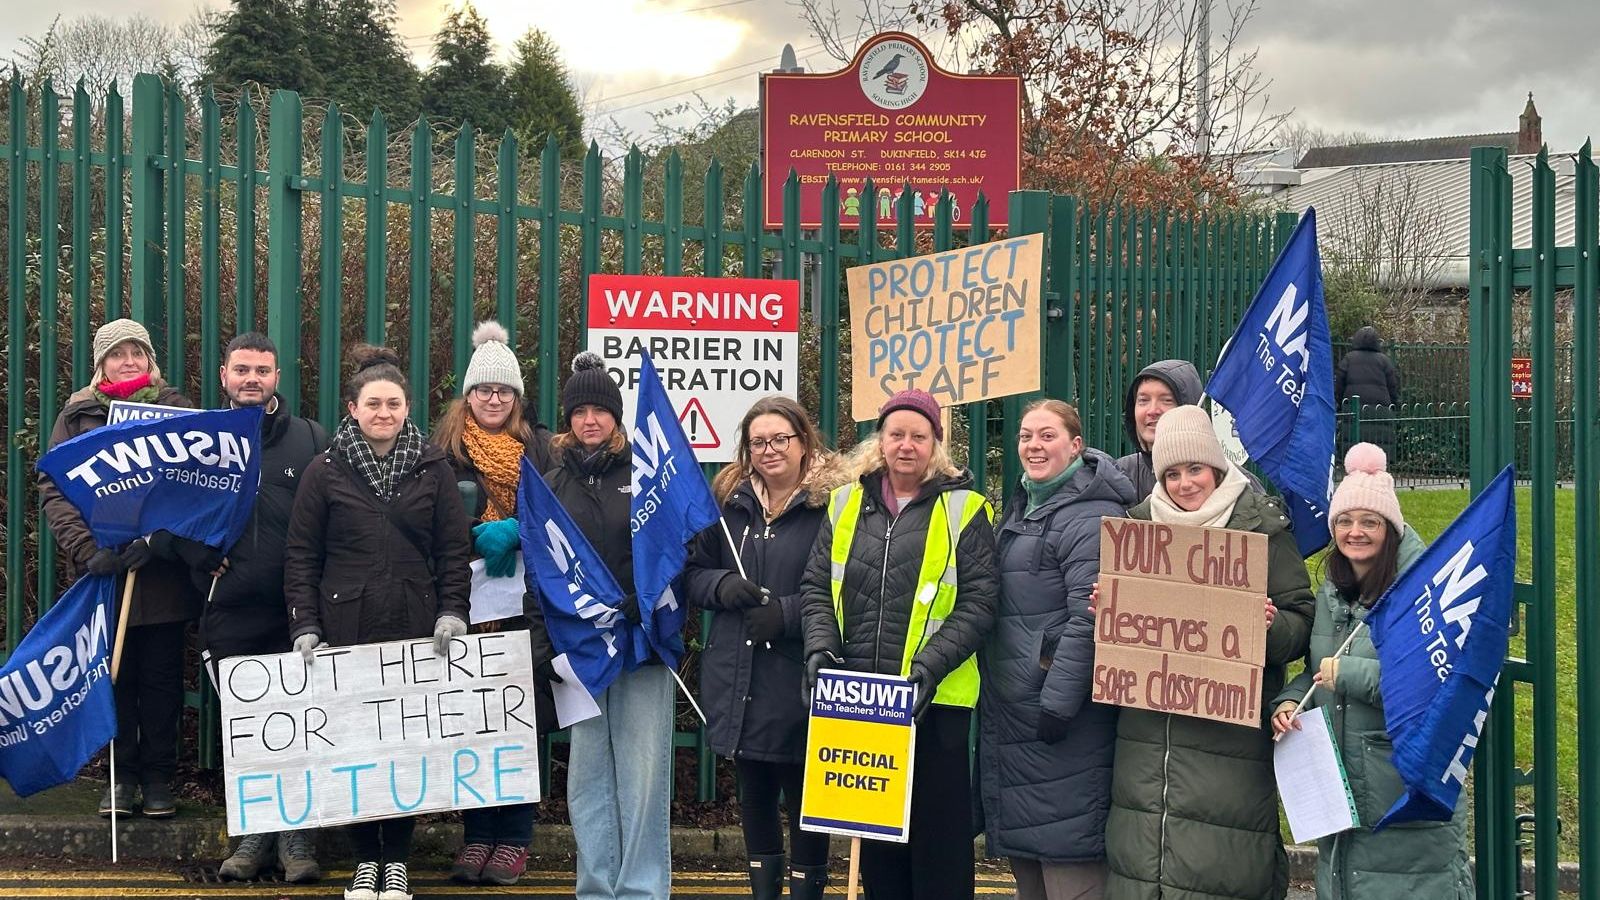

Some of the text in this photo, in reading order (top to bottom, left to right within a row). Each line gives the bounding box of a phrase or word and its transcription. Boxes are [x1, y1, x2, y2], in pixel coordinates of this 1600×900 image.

[889, 42, 915, 56] PRIMARY
[914, 55, 926, 83] SCHOOL
[872, 91, 918, 107] SOARING HIGH
[789, 113, 987, 127] RAVENSFIELD COMMUNITY
[824, 130, 952, 143] PRIMARY SCHOOL
[789, 149, 845, 159] CLARENDON
[850, 149, 866, 159] ST.
[943, 149, 966, 159] SK14
[968, 149, 987, 159] 4JG
[825, 162, 951, 171] TELEPHONE: 0161 344 2905
[868, 239, 1029, 305] PROTECT
[604, 289, 783, 321] WARNING
[864, 278, 1028, 339] CHILDREN
[603, 335, 783, 361] BARRIER IN
[869, 308, 1025, 378] PROTECT
[1255, 332, 1275, 372] The
[879, 355, 1006, 403] STAFF
[1103, 520, 1174, 576] YOUR
[1099, 578, 1242, 659] deserves a
[1414, 583, 1435, 636] The
[228, 634, 508, 702] OUT HERE
[1093, 664, 1137, 706] safe
[815, 677, 913, 709] NASUWT
[815, 700, 905, 719] The Teachers' Union
[229, 684, 534, 758] FOR THEIR
[817, 746, 899, 771] OFFICIAL
[236, 744, 526, 831] FUTURE
[824, 770, 890, 793] PICKET
